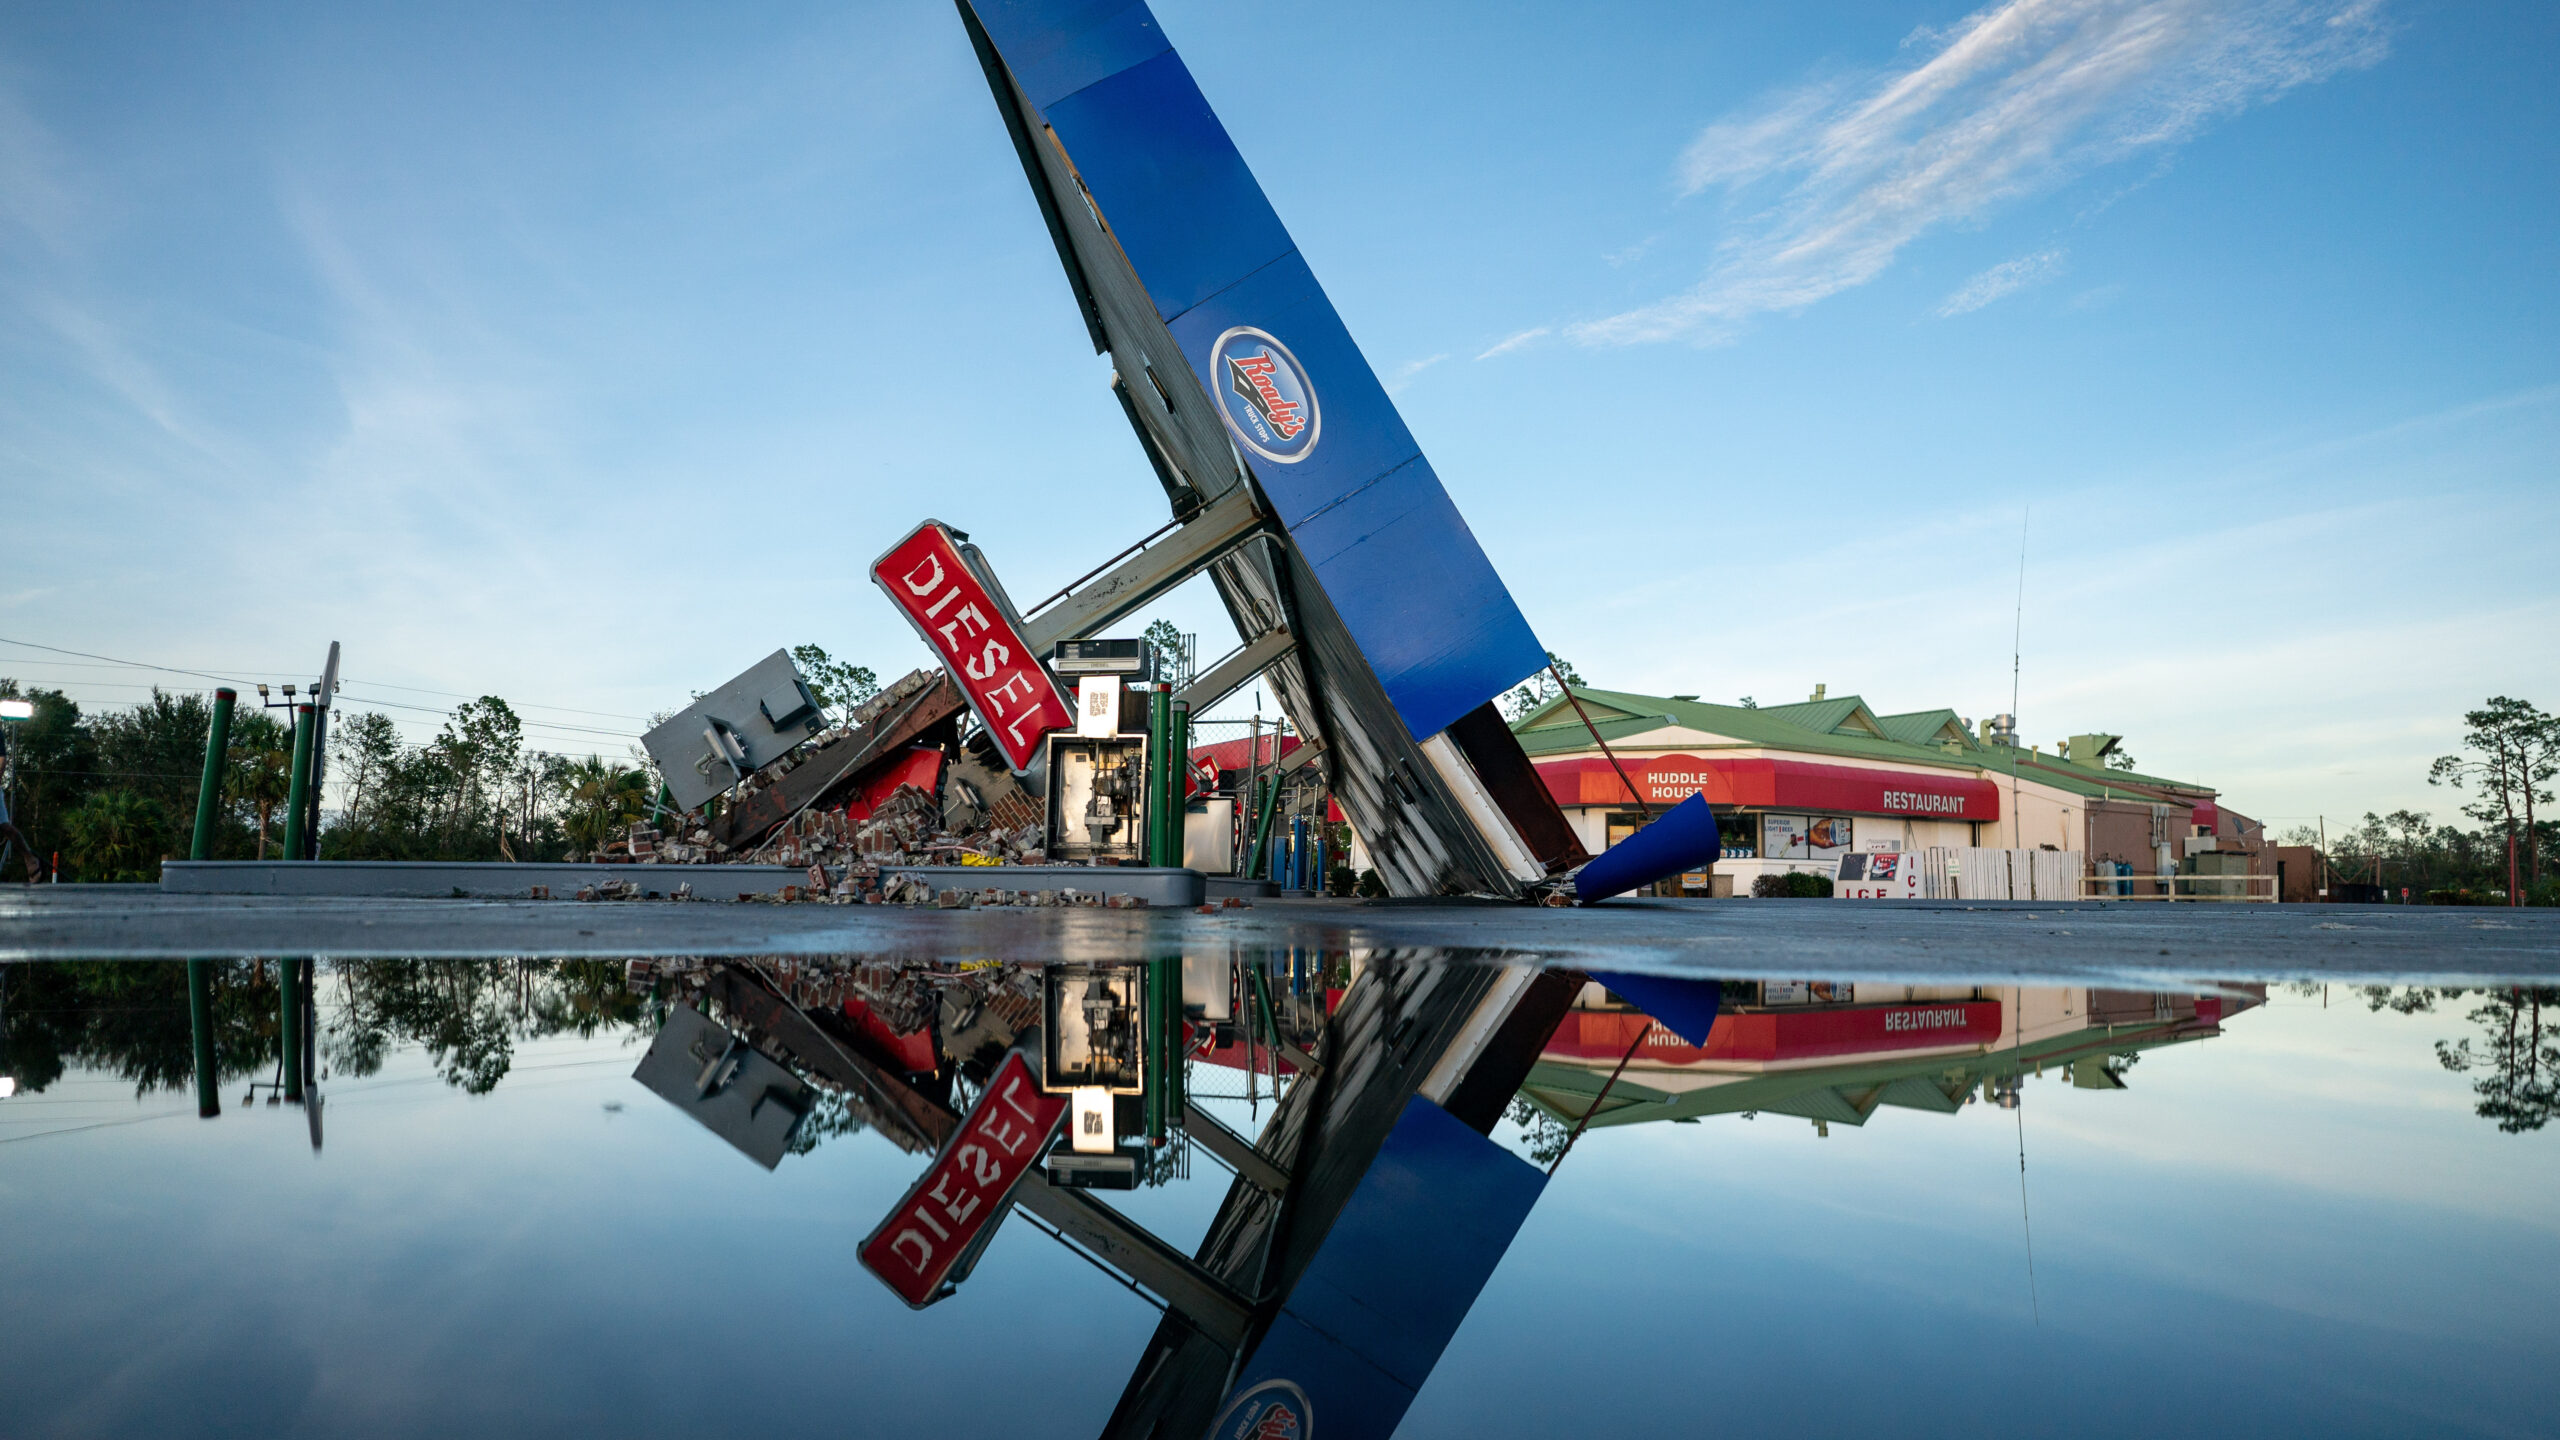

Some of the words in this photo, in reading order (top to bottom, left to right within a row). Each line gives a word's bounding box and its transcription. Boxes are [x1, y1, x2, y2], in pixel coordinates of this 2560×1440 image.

[1232, 350, 1305, 437] Roady's
[1243, 404, 1259, 425] TRUCK
[1254, 422, 1270, 443] STOPS
[902, 551, 1042, 748] DIESEL
[1647, 772, 1708, 784] HUDDLE
[1883, 790, 1965, 814] RESTAURANT
